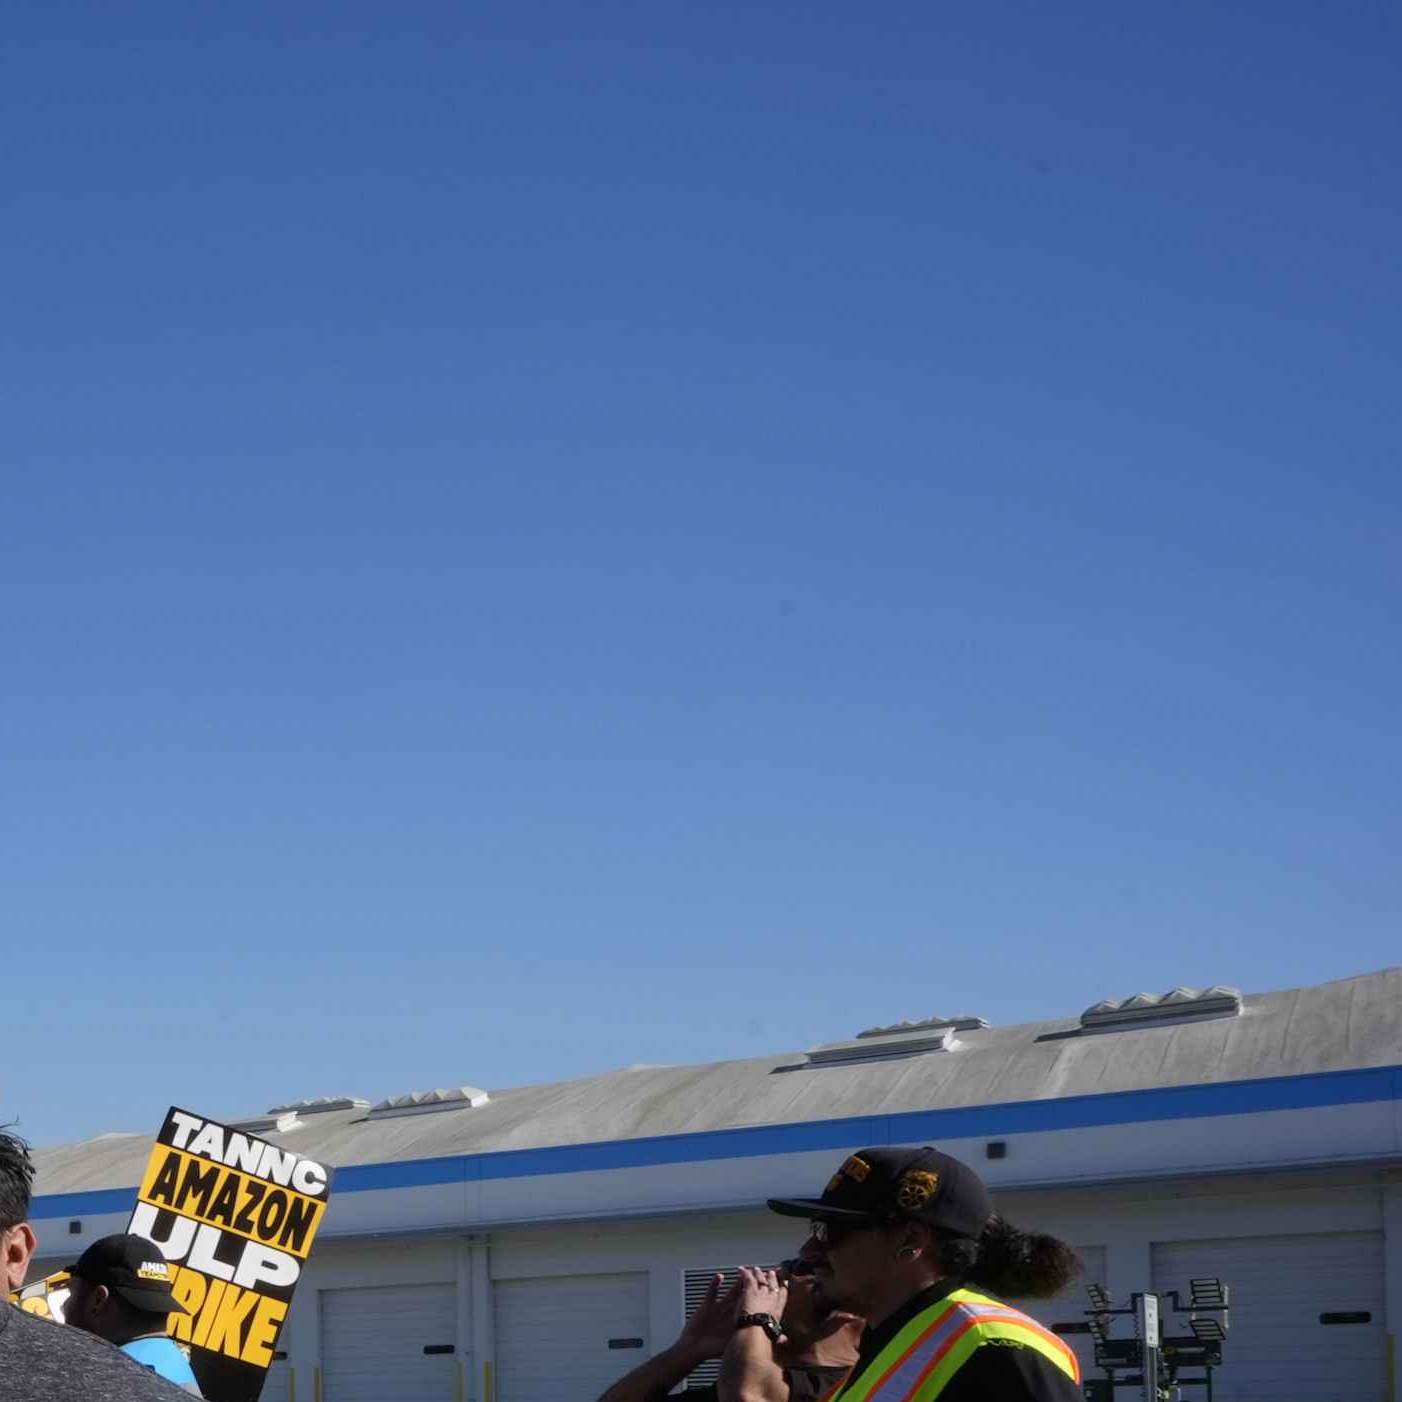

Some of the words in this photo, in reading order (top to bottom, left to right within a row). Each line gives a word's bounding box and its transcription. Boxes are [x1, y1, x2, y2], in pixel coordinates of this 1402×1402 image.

[171, 1110, 328, 1196] TANNC
[128, 1201, 301, 1290] ULP
[147, 1151, 318, 1253] AMAZON
